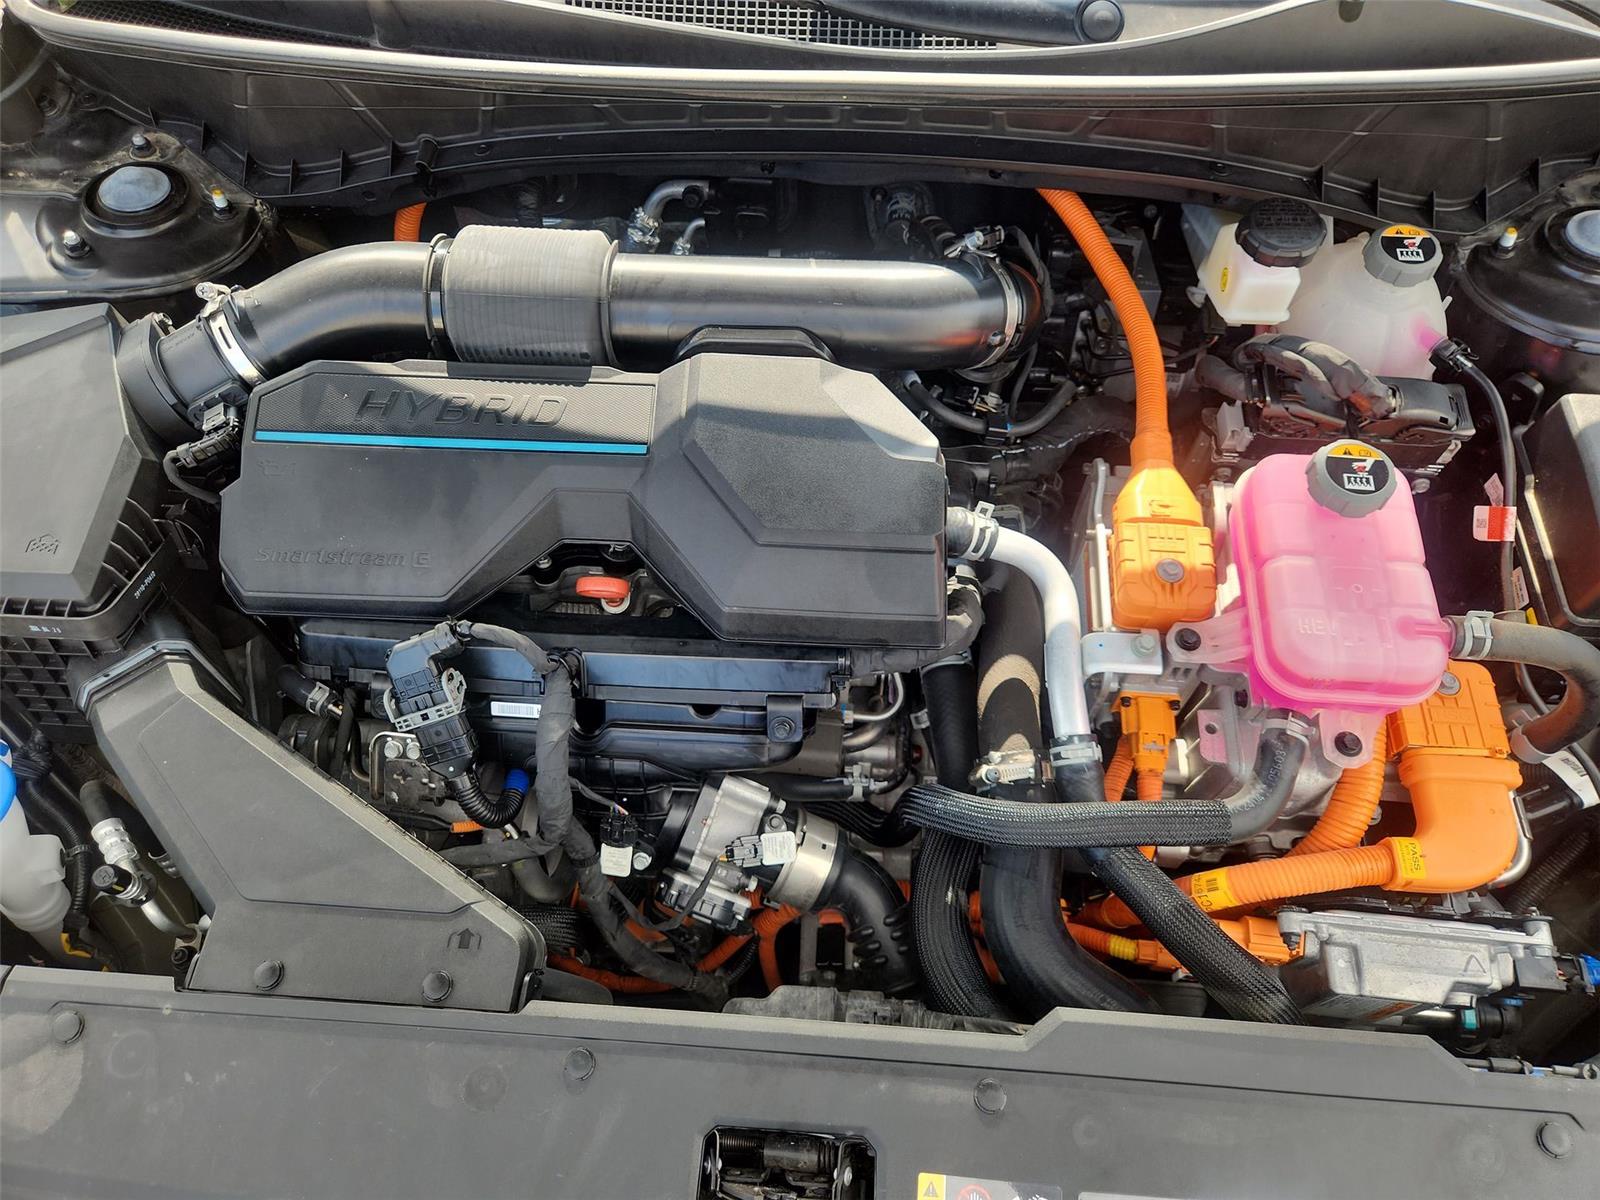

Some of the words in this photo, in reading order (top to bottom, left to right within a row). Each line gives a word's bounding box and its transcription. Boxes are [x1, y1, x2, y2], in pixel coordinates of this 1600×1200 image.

[355, 389, 569, 427] HYBRID
[255, 548, 409, 566] Smartstream
[1409, 842, 1421, 871] PASS
